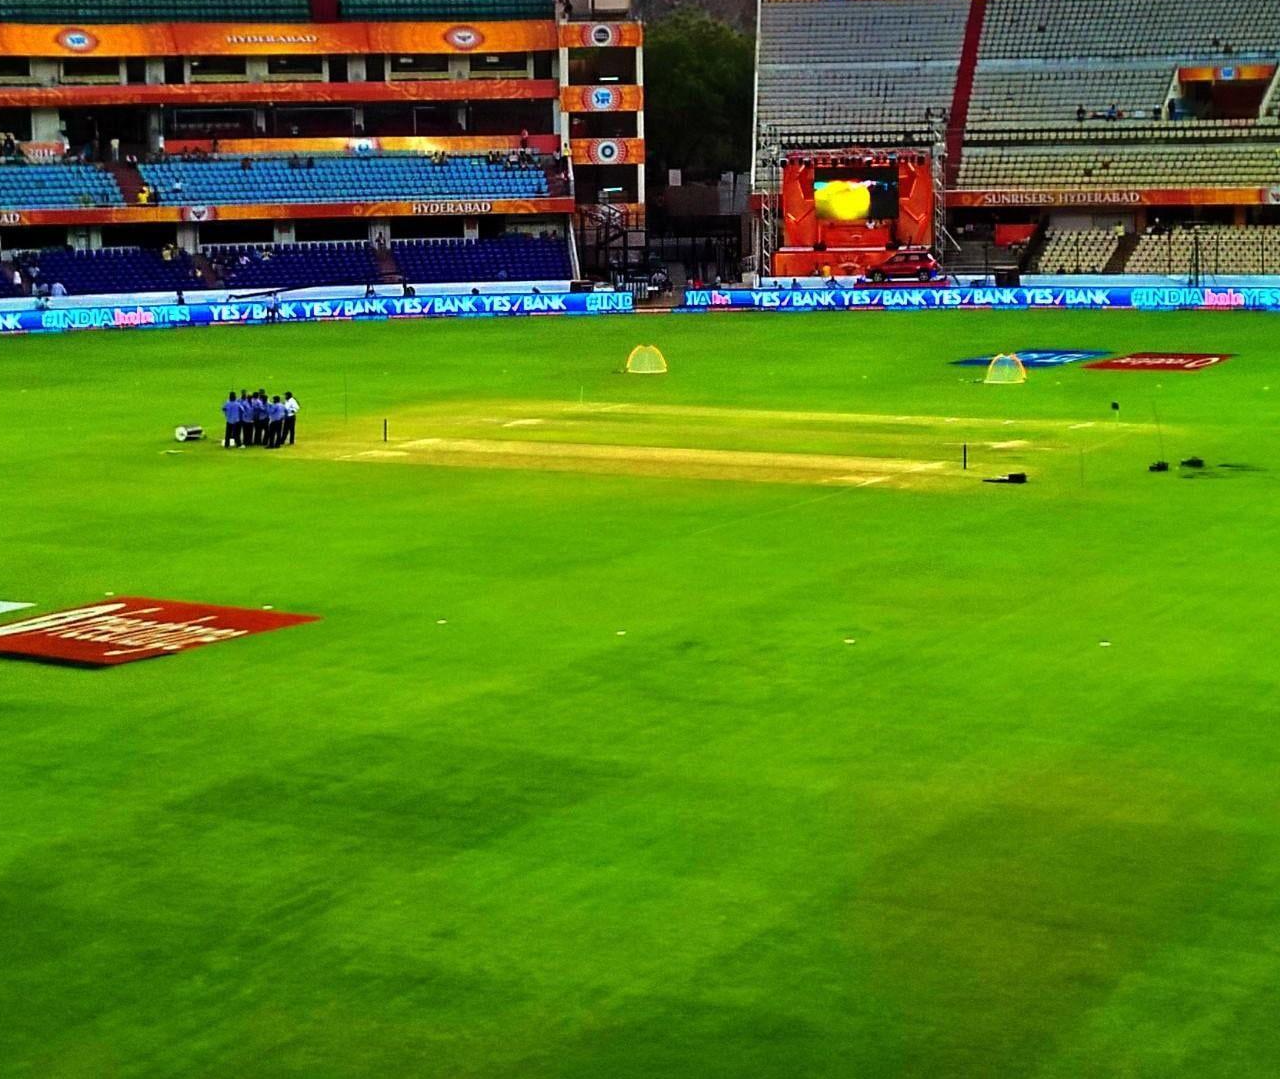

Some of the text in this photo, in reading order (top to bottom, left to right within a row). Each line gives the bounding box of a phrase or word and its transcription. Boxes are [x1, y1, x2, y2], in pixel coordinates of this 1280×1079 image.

[983, 192, 1140, 204] SUNRISERS HYDERABAD
[411, 201, 492, 214] HYDERABAD
[751, 290, 780, 306] YES
[792, 290, 836, 306] BANK
[840, 290, 870, 306] YES
[882, 289, 926, 306] BANK
[930, 289, 962, 305] YES
[974, 288, 1018, 305] BANK
[1023, 288, 1054, 305] YES
[1066, 288, 1110, 305] BANK
[208, 304, 240, 320] YES
[301, 302, 332, 317] YES
[344, 300, 388, 316] BANK
[391, 298, 423, 314] YES
[434, 296, 477, 313] BANK
[481, 296, 512, 312] YES
[523, 294, 567, 310] BANK
